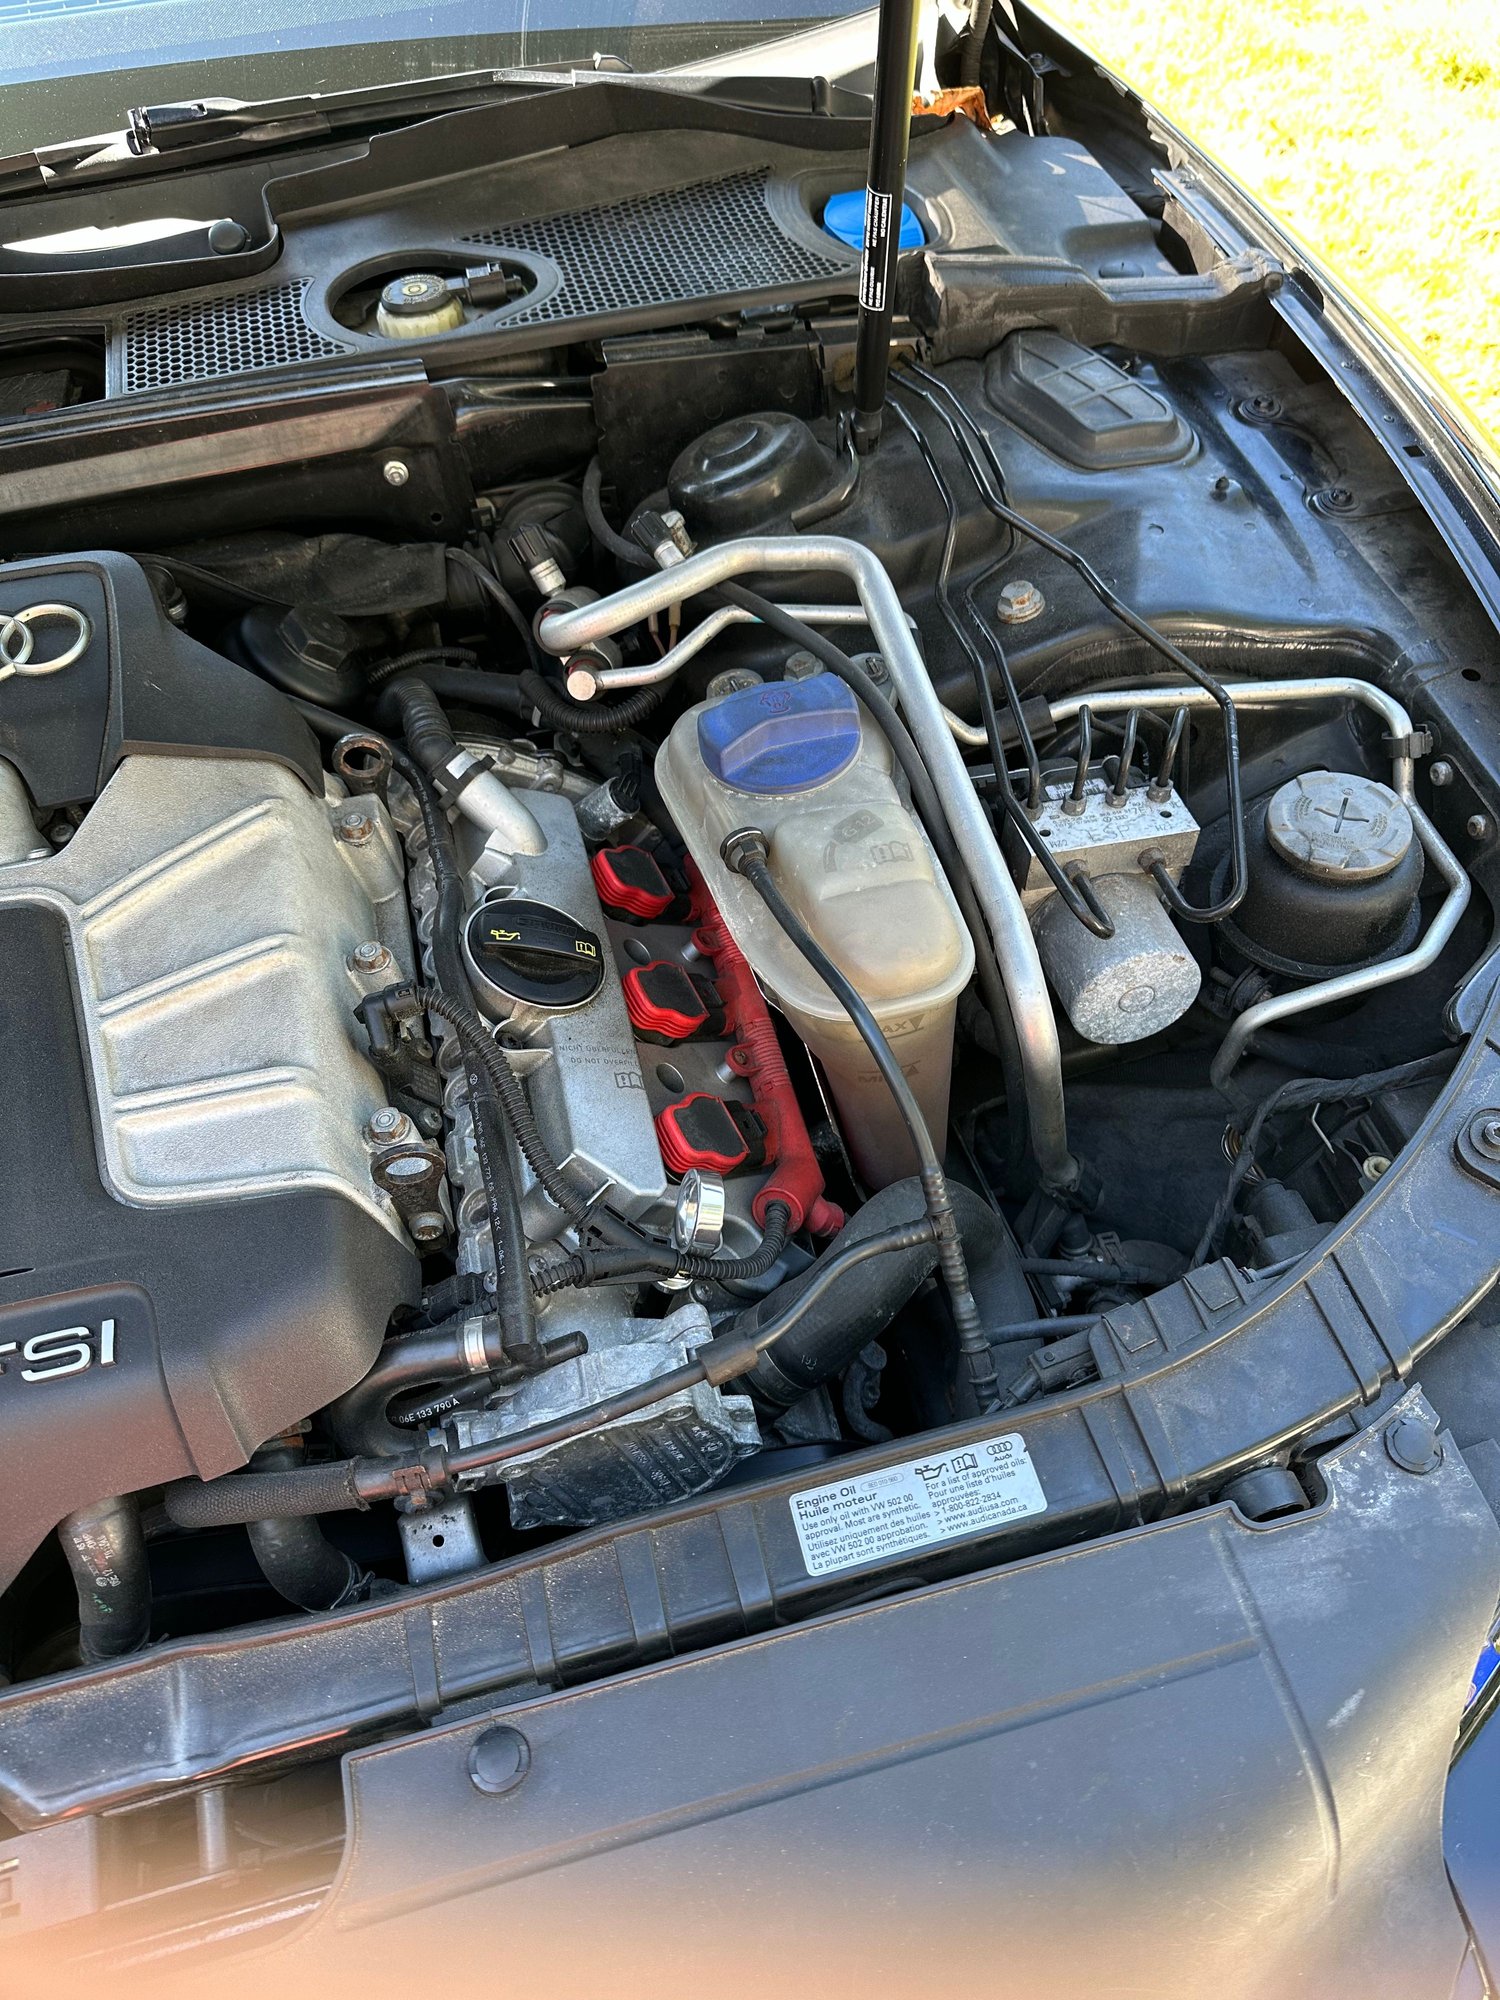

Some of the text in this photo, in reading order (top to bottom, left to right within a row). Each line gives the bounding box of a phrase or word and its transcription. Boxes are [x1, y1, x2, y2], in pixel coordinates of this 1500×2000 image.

[603, 1058, 640, 1067] OVERFILL
[0, 1318, 116, 1383] SI
[398, 1397, 460, 1424] 06E 133 790 A
[993, 1453, 1013, 1462] Audi
[925, 1480, 940, 1491] For
[948, 1475, 961, 1485] list
[961, 1472, 971, 1481] of
[971, 1461, 1010, 1480] approved
[1010, 1457, 1028, 1467] oils:
[928, 1471, 1016, 1500] Pour une liste d'huiles
[796, 1485, 857, 1510] Engine Oil
[799, 1492, 878, 1520] Huile moteur
[802, 1493, 914, 1531] Use only oil with VW 502 00
[932, 1489, 981, 1509] approuvées:
[941, 1491, 1002, 1514] 1-800-822-2834
[944, 1497, 1019, 1524] www.audiusa.com
[805, 1502, 922, 1541] approval. Most are synthetic.
[807, 1510, 931, 1552] Utilisez uniquement des huiles
[947, 1503, 1028, 1532] www.audicanada.ca
[810, 1522, 929, 1561] avec VW 502 00 approbation.
[812, 1531, 931, 1570] La plupart sont synthétiques.
